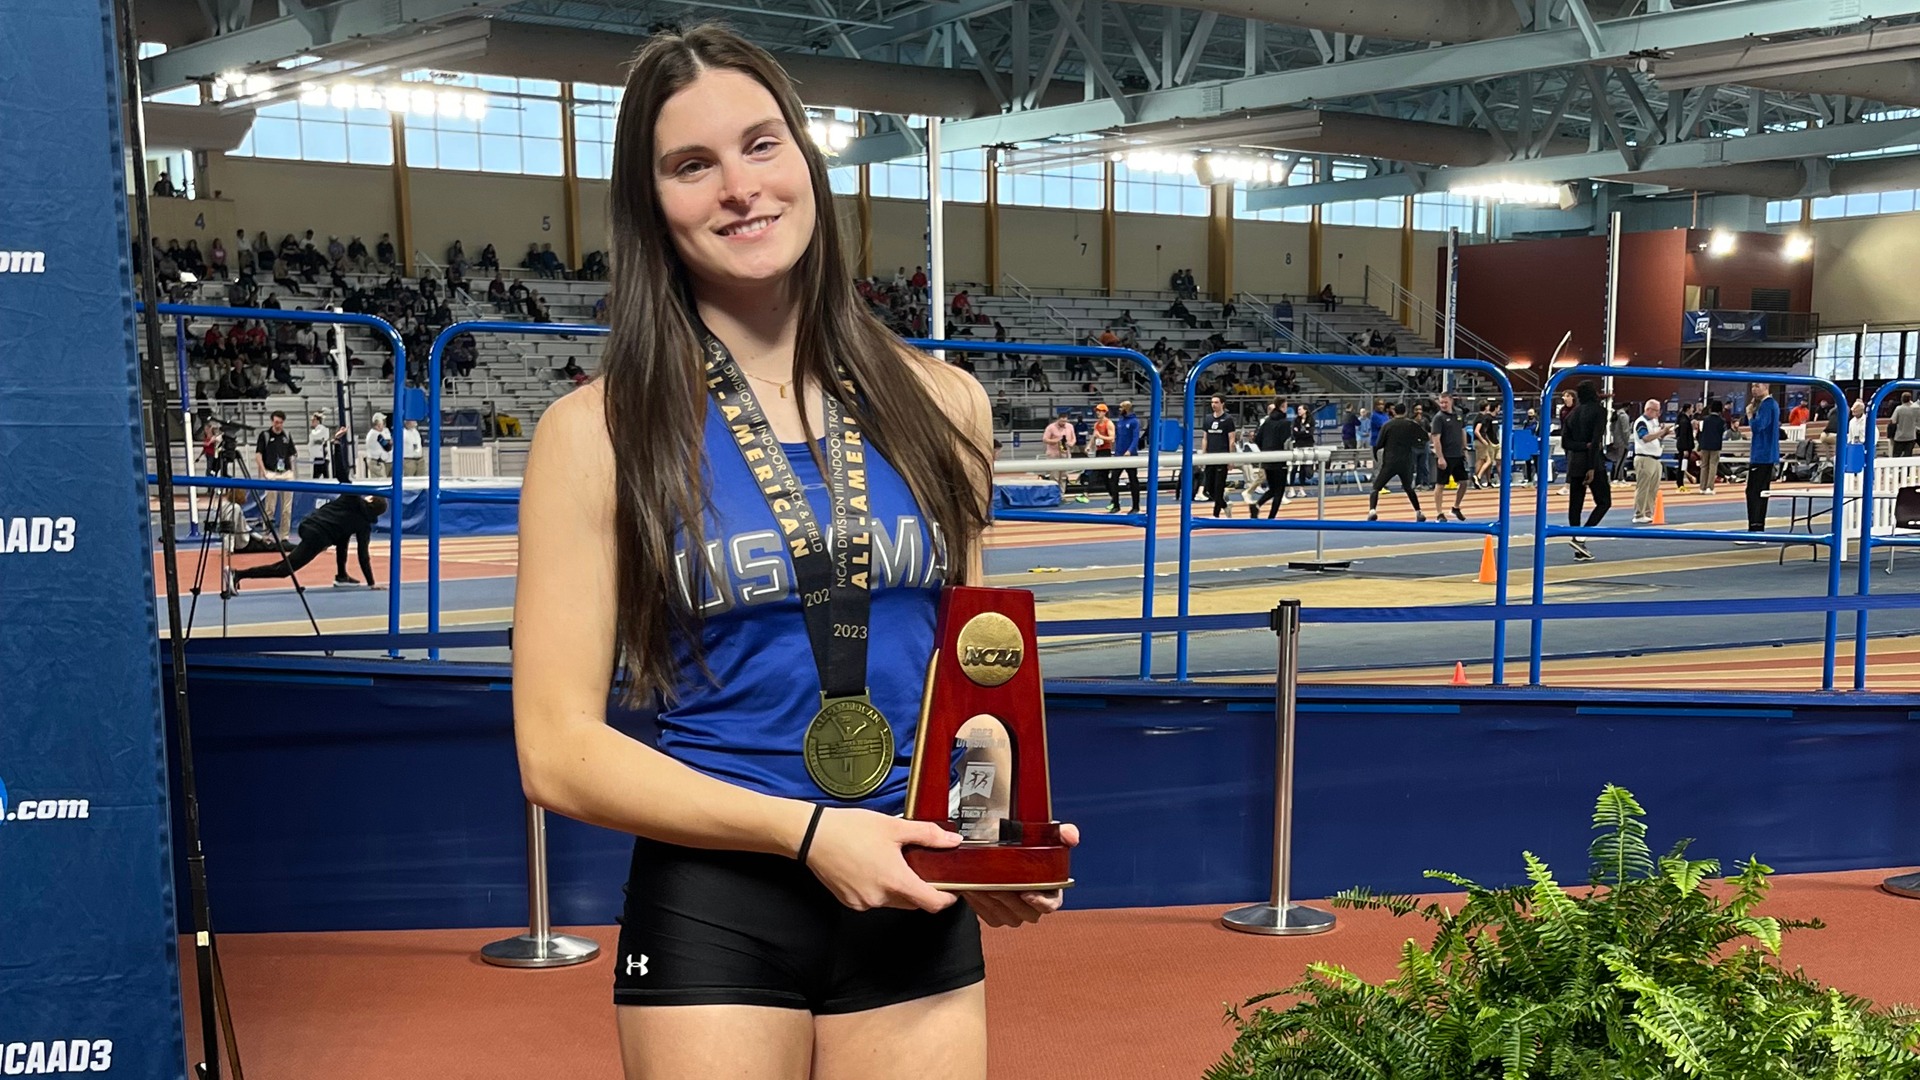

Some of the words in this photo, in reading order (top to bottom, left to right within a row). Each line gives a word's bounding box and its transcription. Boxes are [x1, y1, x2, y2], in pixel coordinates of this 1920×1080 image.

[194, 212, 205, 230] 4
[542, 215, 551, 231] 5
[1081, 242, 1087, 256] 7
[1285, 252, 1292, 265] 8
[704, 335, 727, 366] NCAA
[723, 364, 757, 412] DIVISION
[750, 412, 763, 424] III
[756, 424, 787, 473] INDOOR
[829, 431, 844, 479] INDOOR
[781, 473, 806, 509] TRACK
[834, 482, 845, 493] III
[799, 511, 810, 520] &
[835, 496, 848, 549] DIVISION
[0, 516, 76, 553] AD3
[804, 521, 823, 553] FIELD
[836, 552, 848, 588] NCAA
[804, 588, 831, 608] 202
[833, 624, 868, 640] 2023
[963, 646, 1020, 667] NCAA
[0, 797, 90, 821] .com
[0, 1039, 113, 1075] CAAD3
